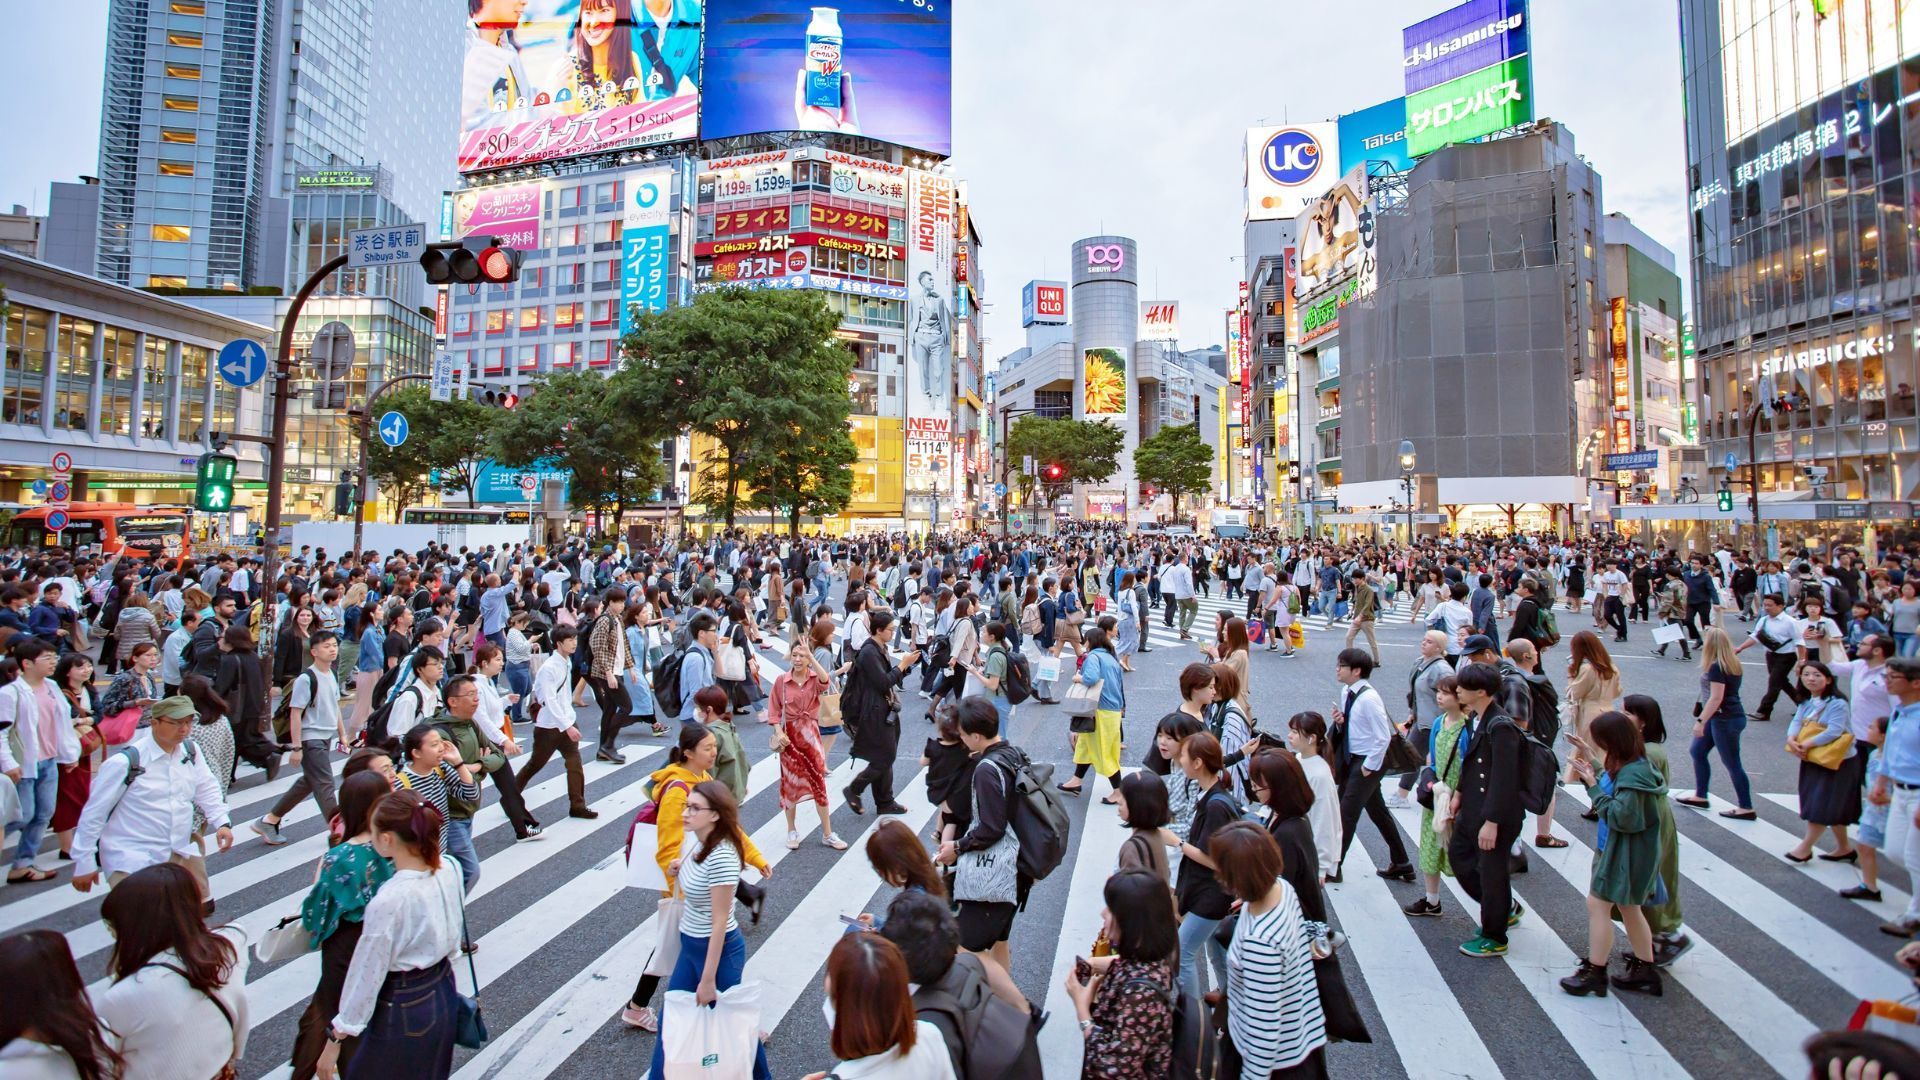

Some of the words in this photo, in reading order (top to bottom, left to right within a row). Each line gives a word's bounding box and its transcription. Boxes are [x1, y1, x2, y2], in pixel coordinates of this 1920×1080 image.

[1403, 12, 1522, 67] Hisamitsu
[518, 98, 524, 107] 2
[539, 95, 546, 104] 3
[560, 90, 567, 99] 4
[583, 86, 589, 95] 5
[605, 83, 612, 92] 6
[628, 78, 635, 87] 7
[652, 74, 658, 84] 8
[1412, 79, 1521, 134] サロンパス
[523, 116, 601, 152] オークス
[609, 113, 646, 135] 5.19
[649, 112, 675, 124] SUN
[708, 151, 787, 171] しゃぶしゃぶバイキング
[825, 150, 905, 175] しゃぶしゃぶバイキング
[300, 176, 336, 184] MARK
[339, 176, 372, 184] CITY
[700, 183, 714, 194] 9F
[754, 174, 791, 193] 1,599円
[856, 176, 903, 199] しゃぶ葉
[493, 191, 537, 206] 品川スキン
[935, 177, 950, 223] EXILE
[493, 204, 532, 218] クリニック
[715, 208, 788, 232] プライス
[811, 206, 886, 233] コンタクト
[919, 175, 935, 252] SHOKICHI
[354, 229, 420, 251] 渋谷駅前
[758, 235, 796, 252] ガスト
[364, 252, 395, 262] Shibuya
[397, 250, 411, 261] Sta.
[864, 243, 898, 260] ガスト
[1085, 244, 1124, 272] 109
[649, 235, 663, 312] コンタクト
[696, 265, 713, 278] 7F
[717, 263, 736, 272] Café
[737, 257, 782, 278] ガスト
[842, 281, 906, 297] 英会話イーオン
[1040, 290, 1060, 301] UNI
[1040, 301, 1061, 312] QLO
[1146, 305, 1174, 324] H&M
[1761, 335, 1895, 376] STARBUCKS
[909, 417, 948, 431] NEW
[909, 431, 949, 440] ALBUM
